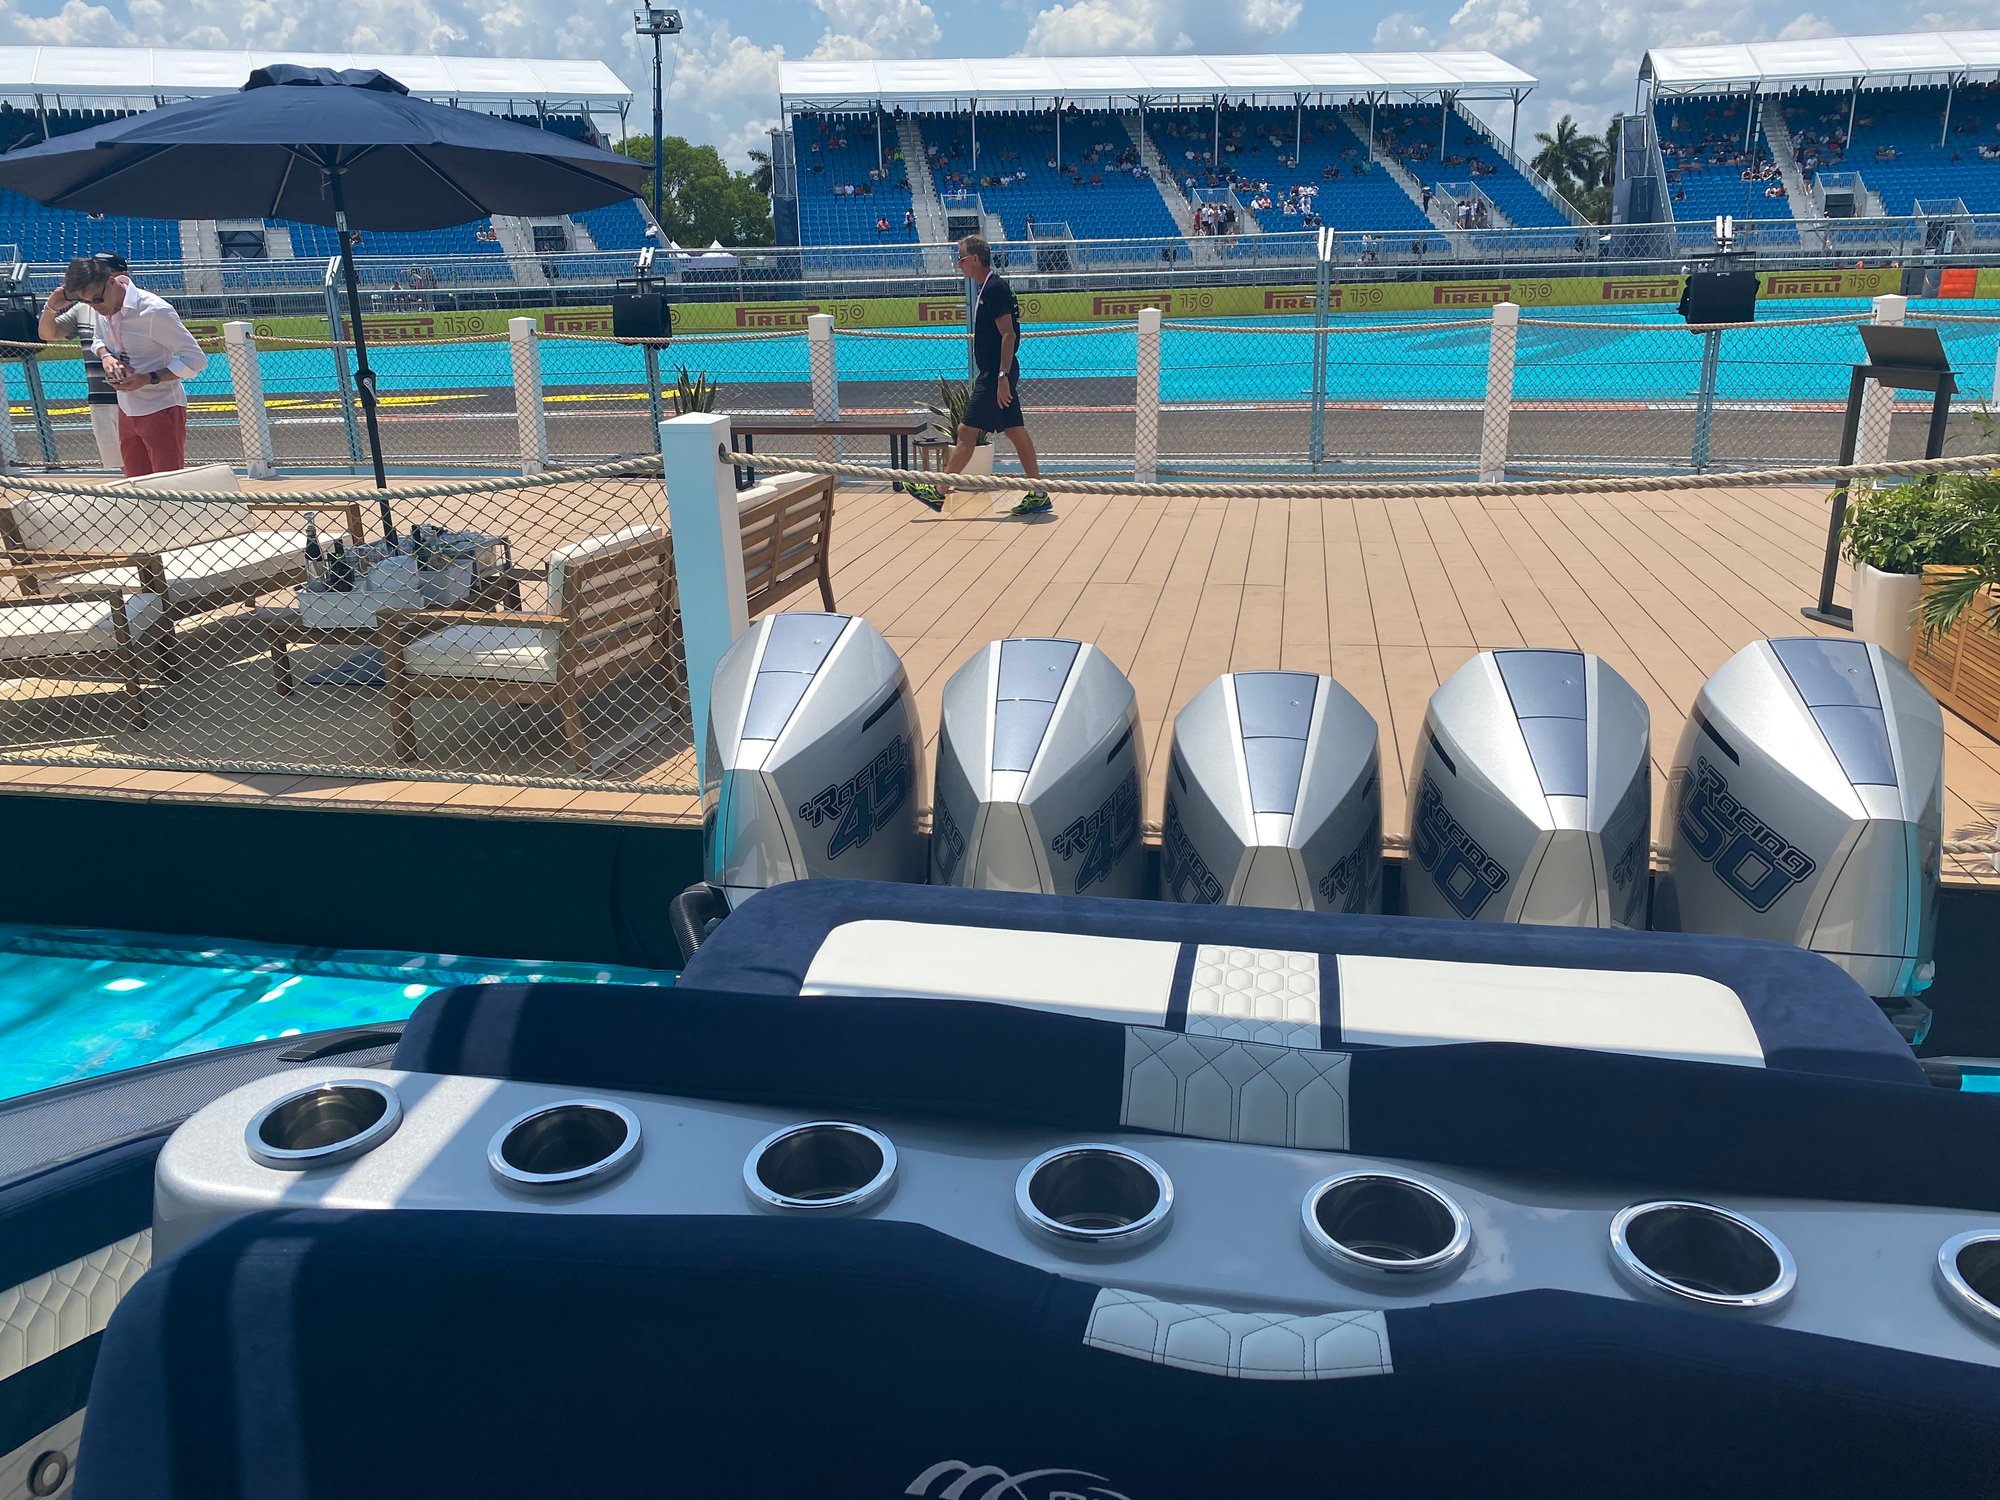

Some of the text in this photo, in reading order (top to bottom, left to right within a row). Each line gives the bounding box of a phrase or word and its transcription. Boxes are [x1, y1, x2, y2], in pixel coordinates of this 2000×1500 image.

[1433, 285, 1511, 304] PIRELLI
[1602, 279, 1679, 299] PIRELLI
[1766, 275, 1842, 294] PIRELLI
[736, 306, 820, 327] PIRELL
[918, 302, 967, 321] PIRE
[342, 318, 434, 342] PRELLI
[544, 312, 614, 334] PIREL
